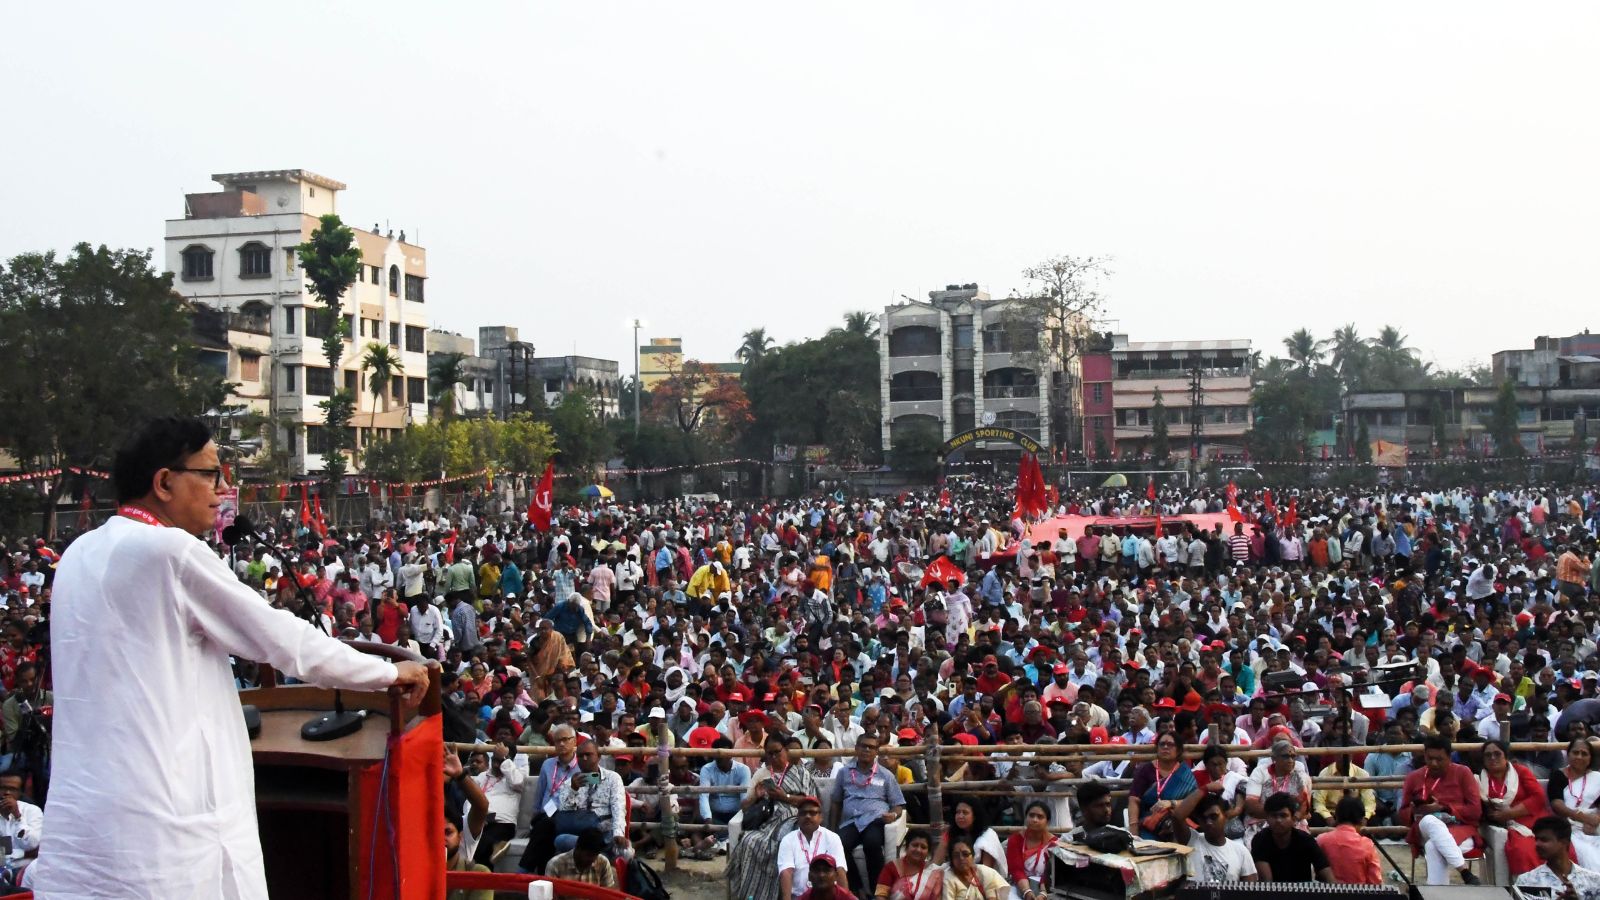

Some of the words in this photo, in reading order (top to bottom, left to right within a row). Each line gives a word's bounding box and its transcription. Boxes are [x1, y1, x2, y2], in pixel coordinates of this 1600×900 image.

[950, 433, 974, 448] NKUNI
[975, 429, 1014, 439] SPORTING
[1020, 437, 1038, 452] CLUB
